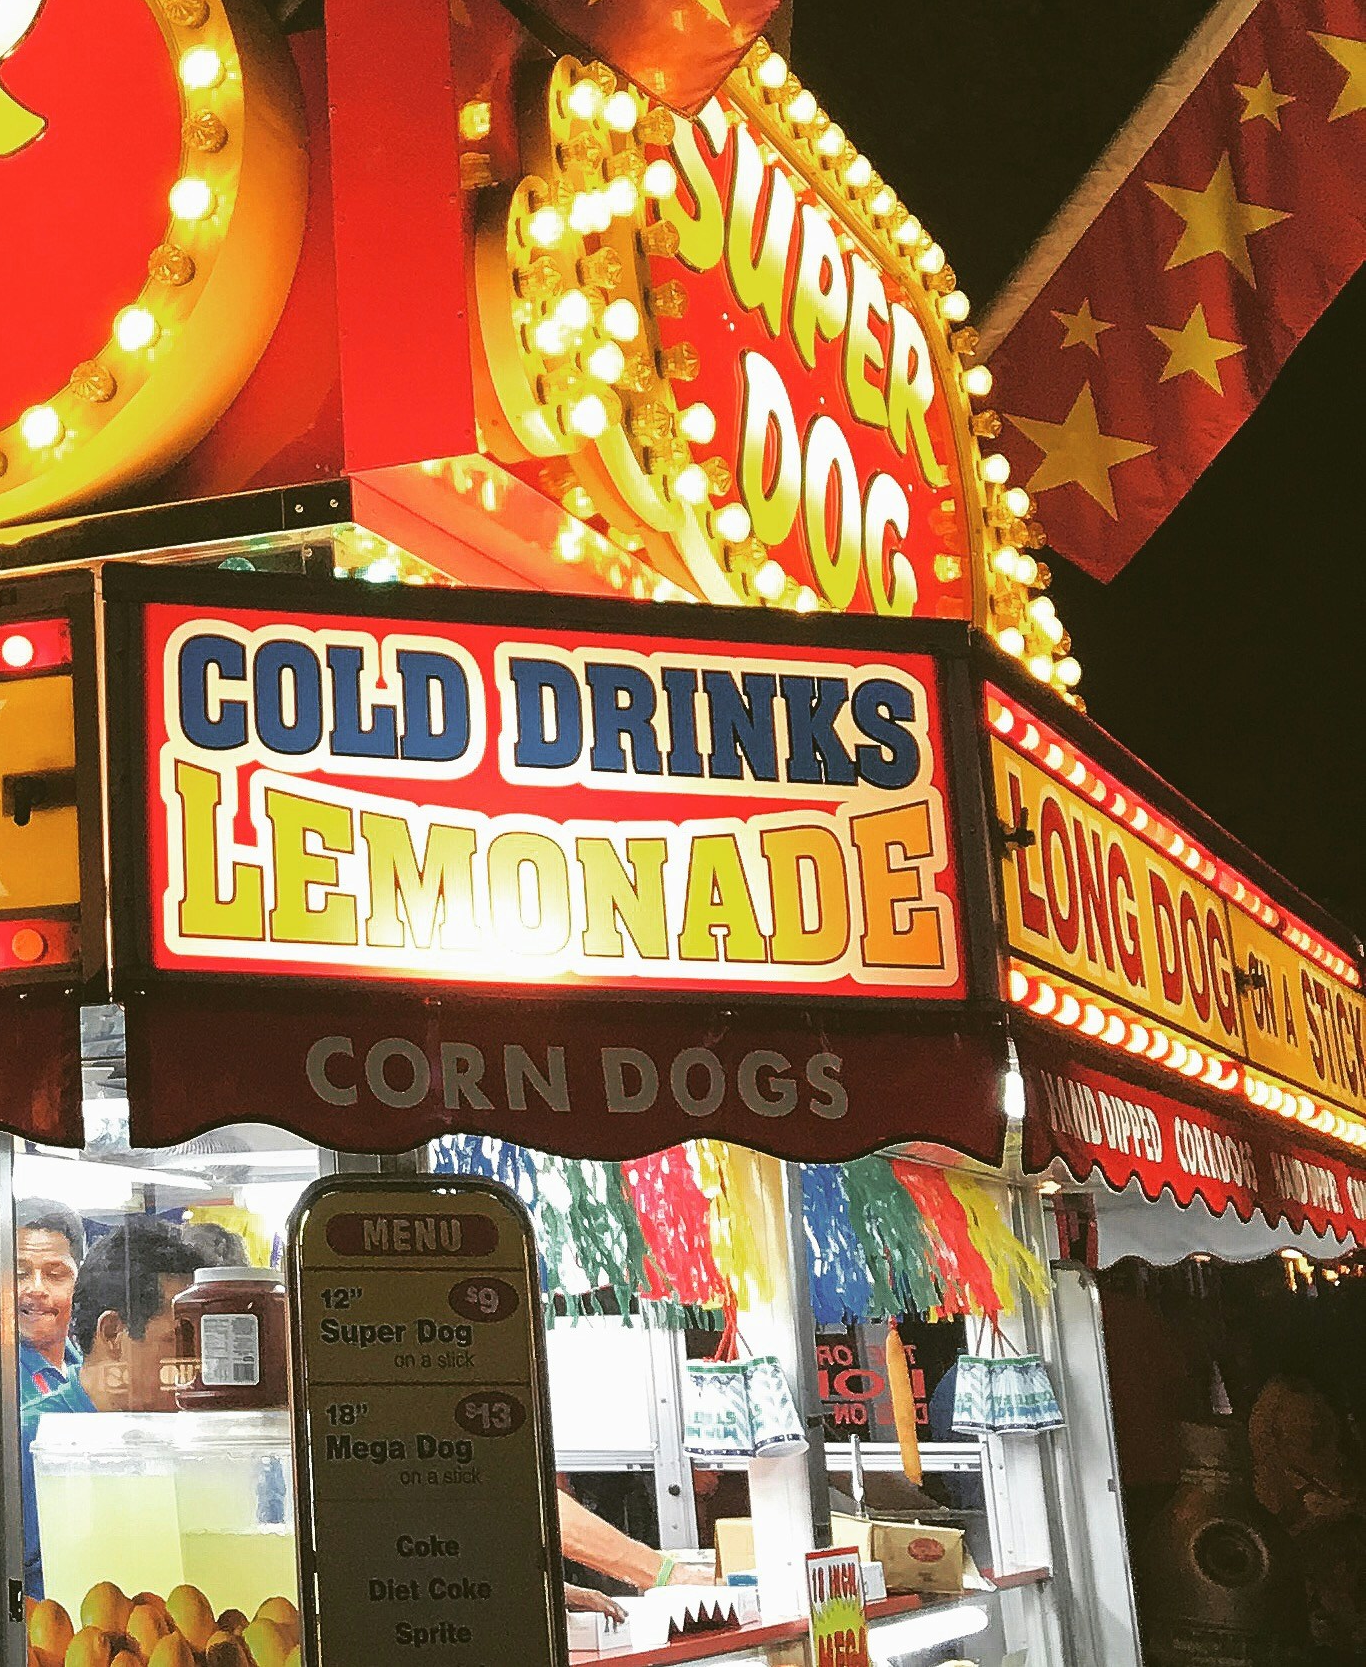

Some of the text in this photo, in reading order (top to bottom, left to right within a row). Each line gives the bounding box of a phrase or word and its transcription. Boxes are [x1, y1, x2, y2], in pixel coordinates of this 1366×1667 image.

[658, 94, 951, 488] SUPER
[739, 350, 919, 618] DOG
[175, 631, 920, 791] COLD DRINKS
[171, 761, 948, 972] LEMONADE
[1007, 770, 1147, 990] LONG
[1148, 868, 1240, 1038] DOG
[1282, 973, 1300, 1049] A
[1300, 968, 1366, 1100] STICK
[304, 1035, 852, 1122] CORN DOGS
[1040, 1068, 1103, 1146] HAND
[1097, 1090, 1163, 1164] DIPPED
[362, 1218, 465, 1254] MENU
[465, 1285, 501, 1317] $9
[319, 1319, 474, 1349] Super Dog
[393, 1350, 476, 1369] on a stick
[465, 1402, 513, 1431] $13
[325, 1435, 474, 1464] Mega Dog
[400, 1465, 482, 1485] on a stick
[395, 1534, 461, 1559] Coke
[368, 1578, 493, 1602] Diet Coke
[395, 1620, 473, 1649] Sprite
